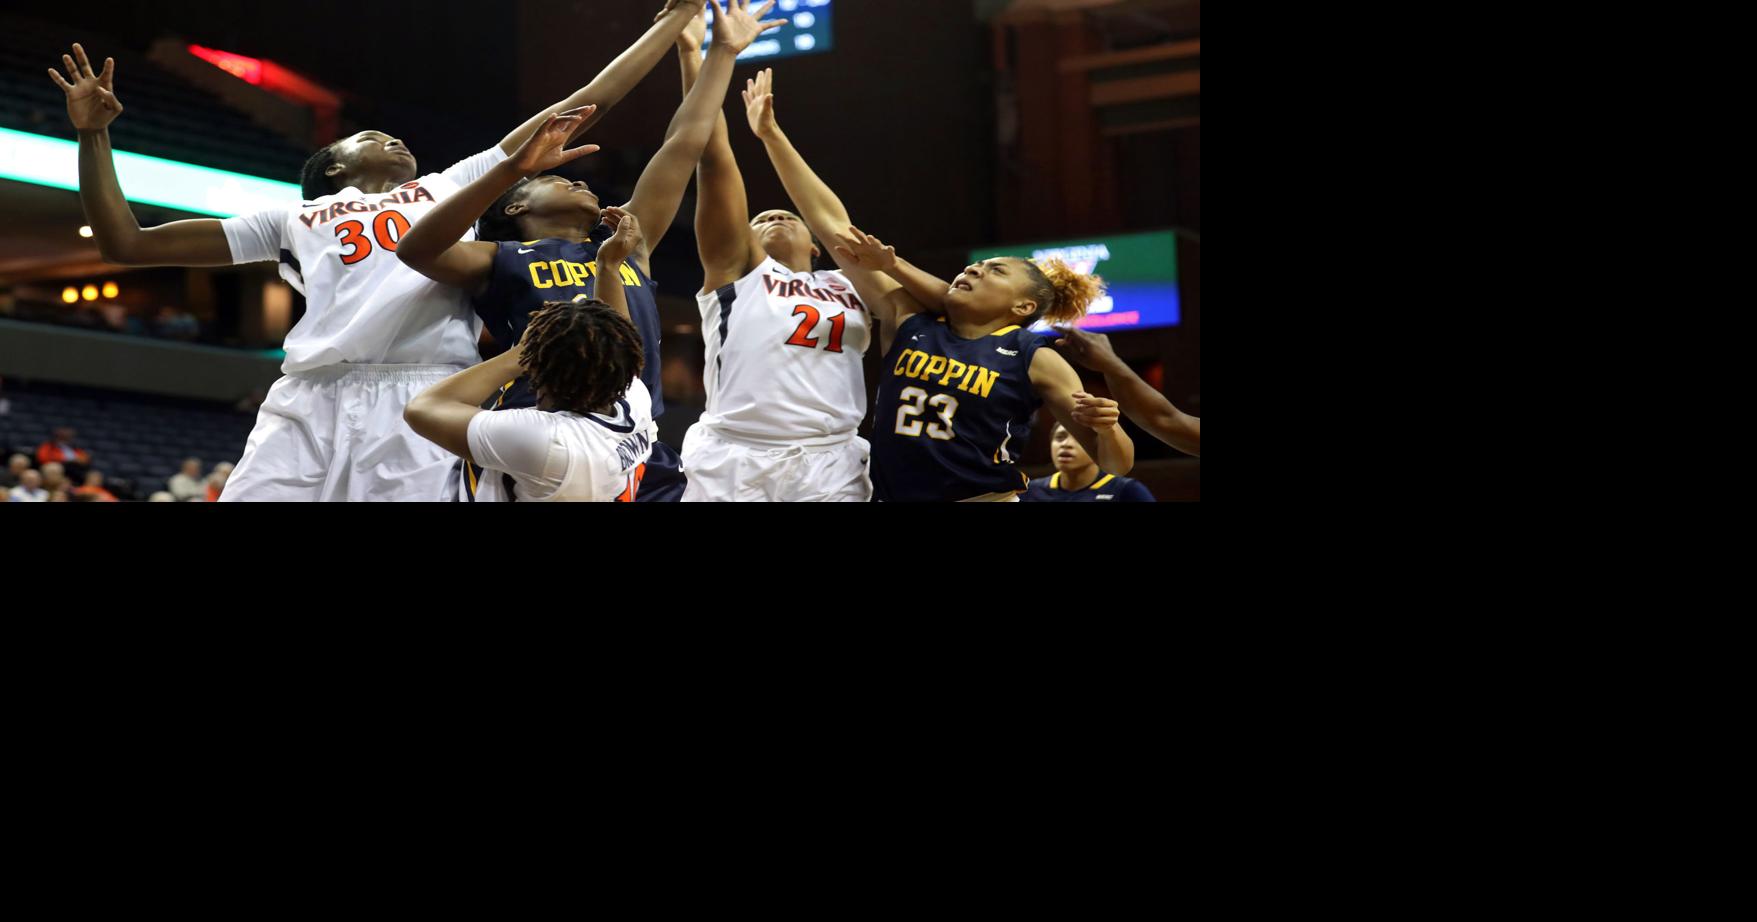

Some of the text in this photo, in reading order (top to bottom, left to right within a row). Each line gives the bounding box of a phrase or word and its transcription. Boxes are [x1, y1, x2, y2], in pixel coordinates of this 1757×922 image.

[299, 186, 436, 231] VIRGINIA
[334, 209, 412, 265] 30
[528, 259, 642, 289] COPN
[784, 304, 846, 353] 21
[894, 348, 1001, 399] COPPIN
[895, 386, 959, 441] 23
[615, 429, 649, 472] BROWN
